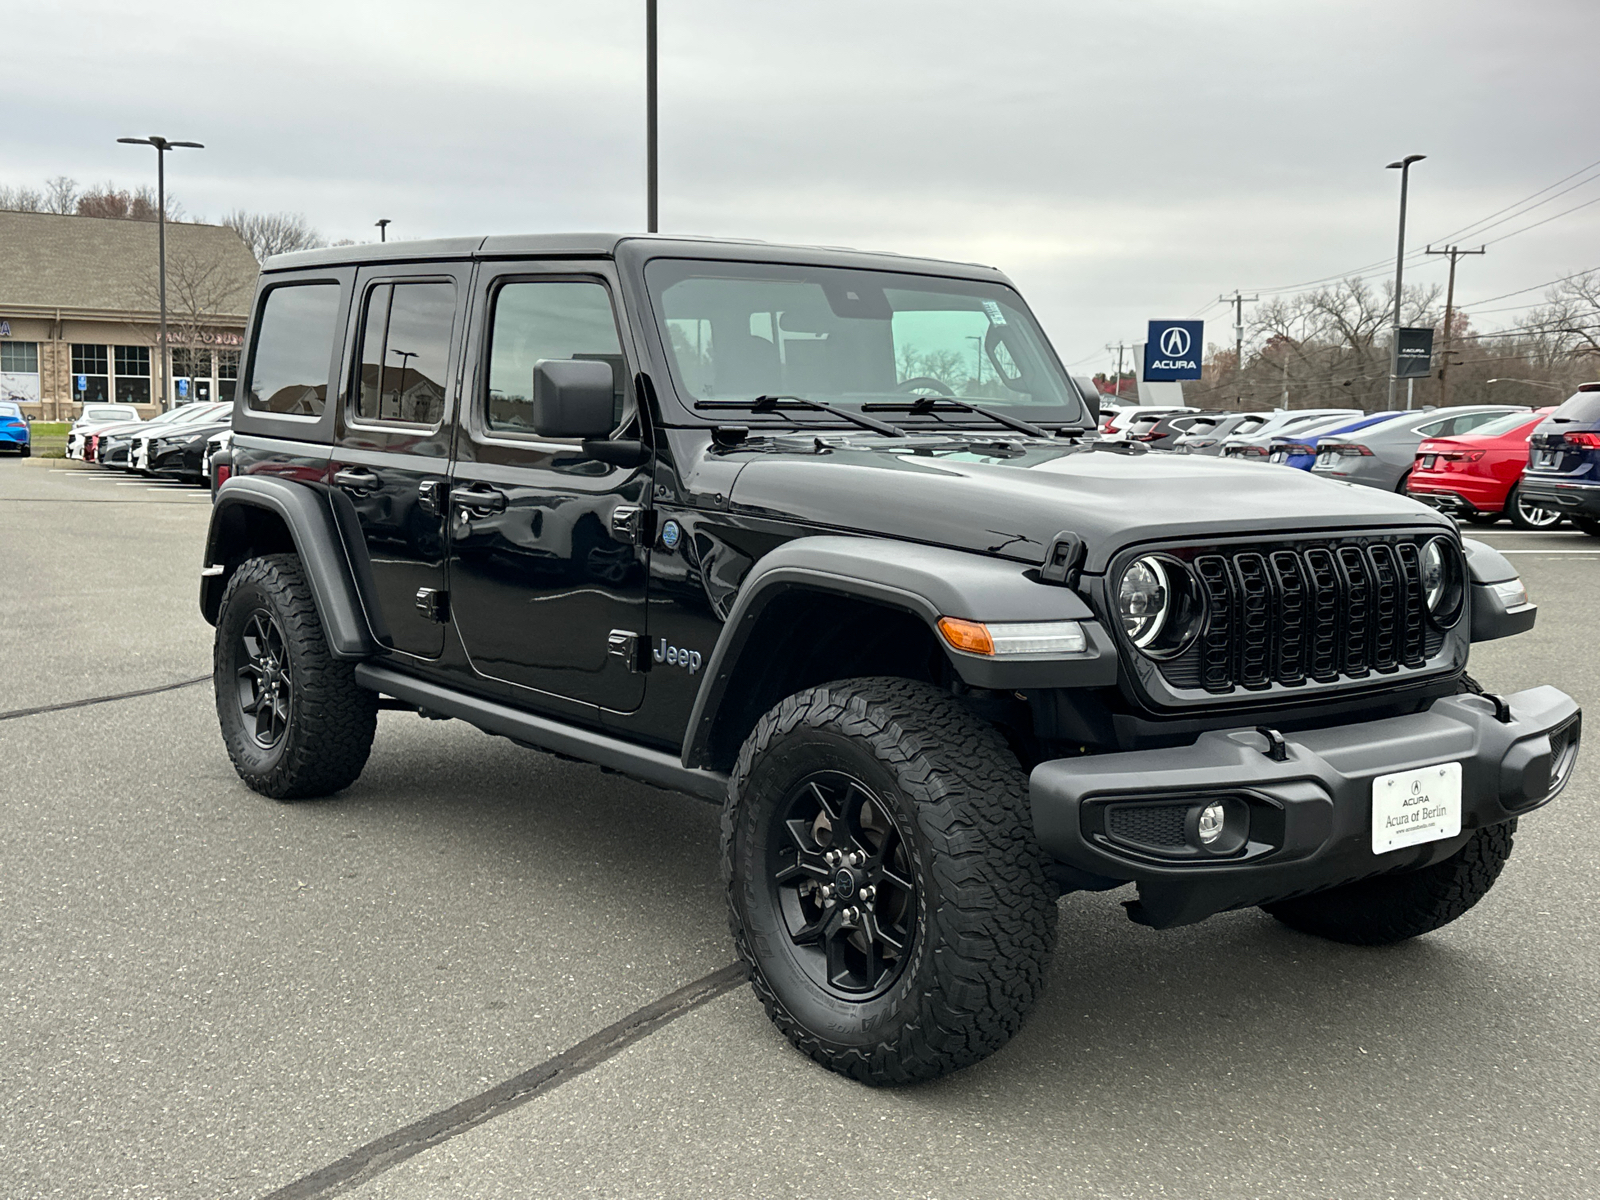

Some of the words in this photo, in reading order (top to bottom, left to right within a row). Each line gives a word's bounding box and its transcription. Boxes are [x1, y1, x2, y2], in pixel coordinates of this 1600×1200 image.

[1152, 360, 1197, 369] ACURA
[653, 638, 702, 674] Jeep
[1402, 795, 1430, 807] ACURA
[1386, 815, 1409, 828] Acura
[1411, 810, 1420, 821] of
[1422, 804, 1447, 820] Berlin
